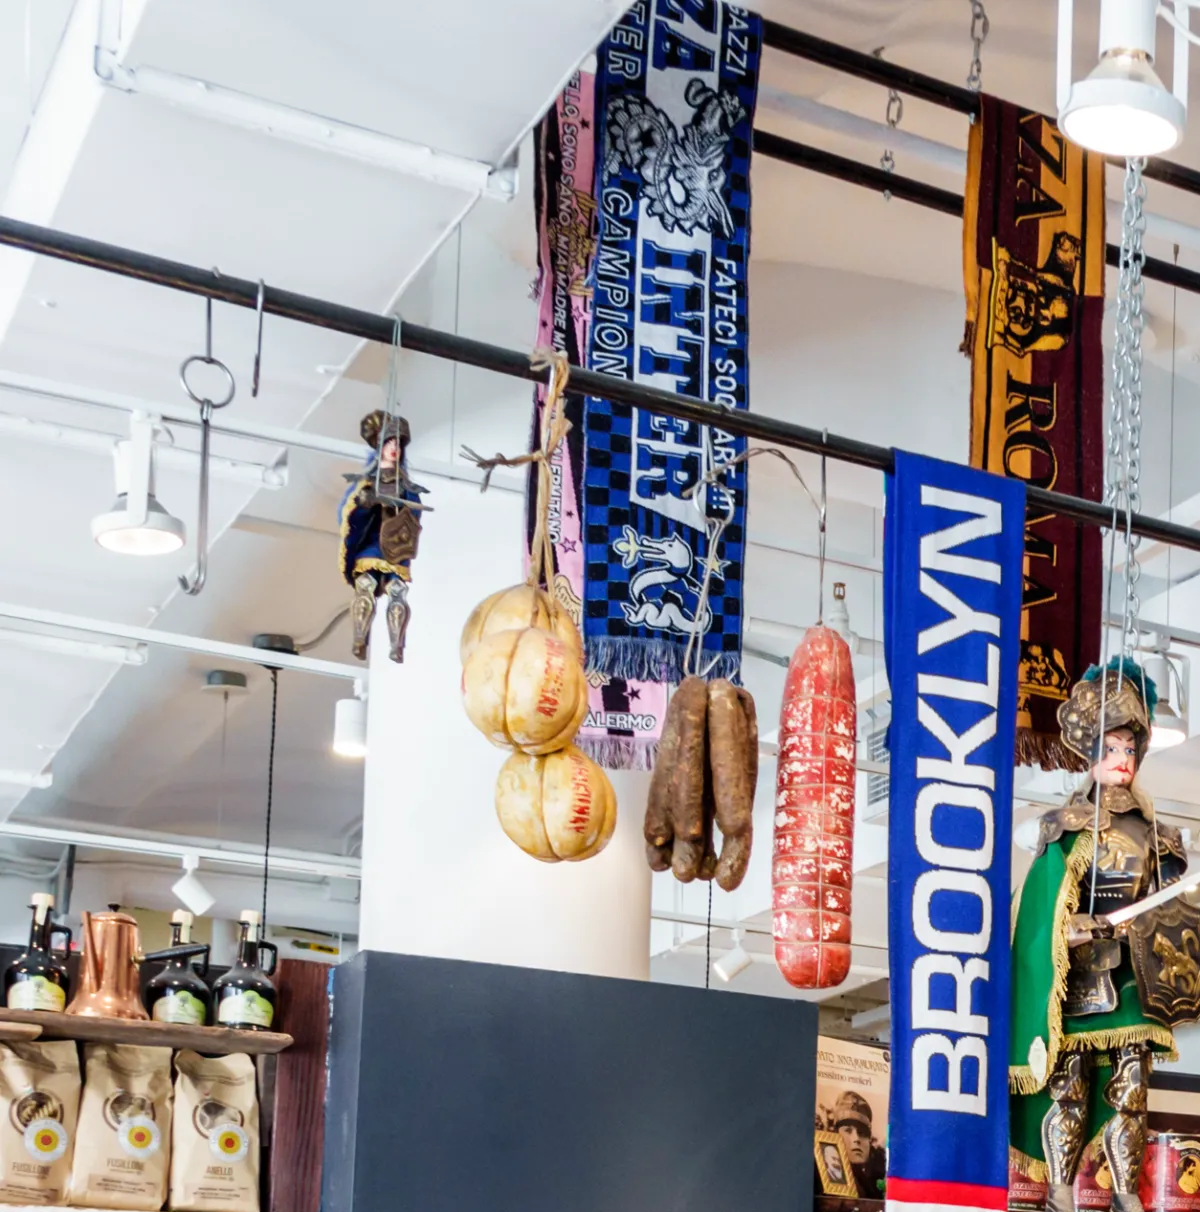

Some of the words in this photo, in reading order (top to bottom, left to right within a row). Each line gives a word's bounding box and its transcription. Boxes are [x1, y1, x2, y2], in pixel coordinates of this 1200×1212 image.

[592, 187, 633, 402] CAMPION
[713, 257, 738, 346] FATECI
[584, 711, 657, 731] ALERMO
[910, 483, 1002, 1117] BROOKLYN
